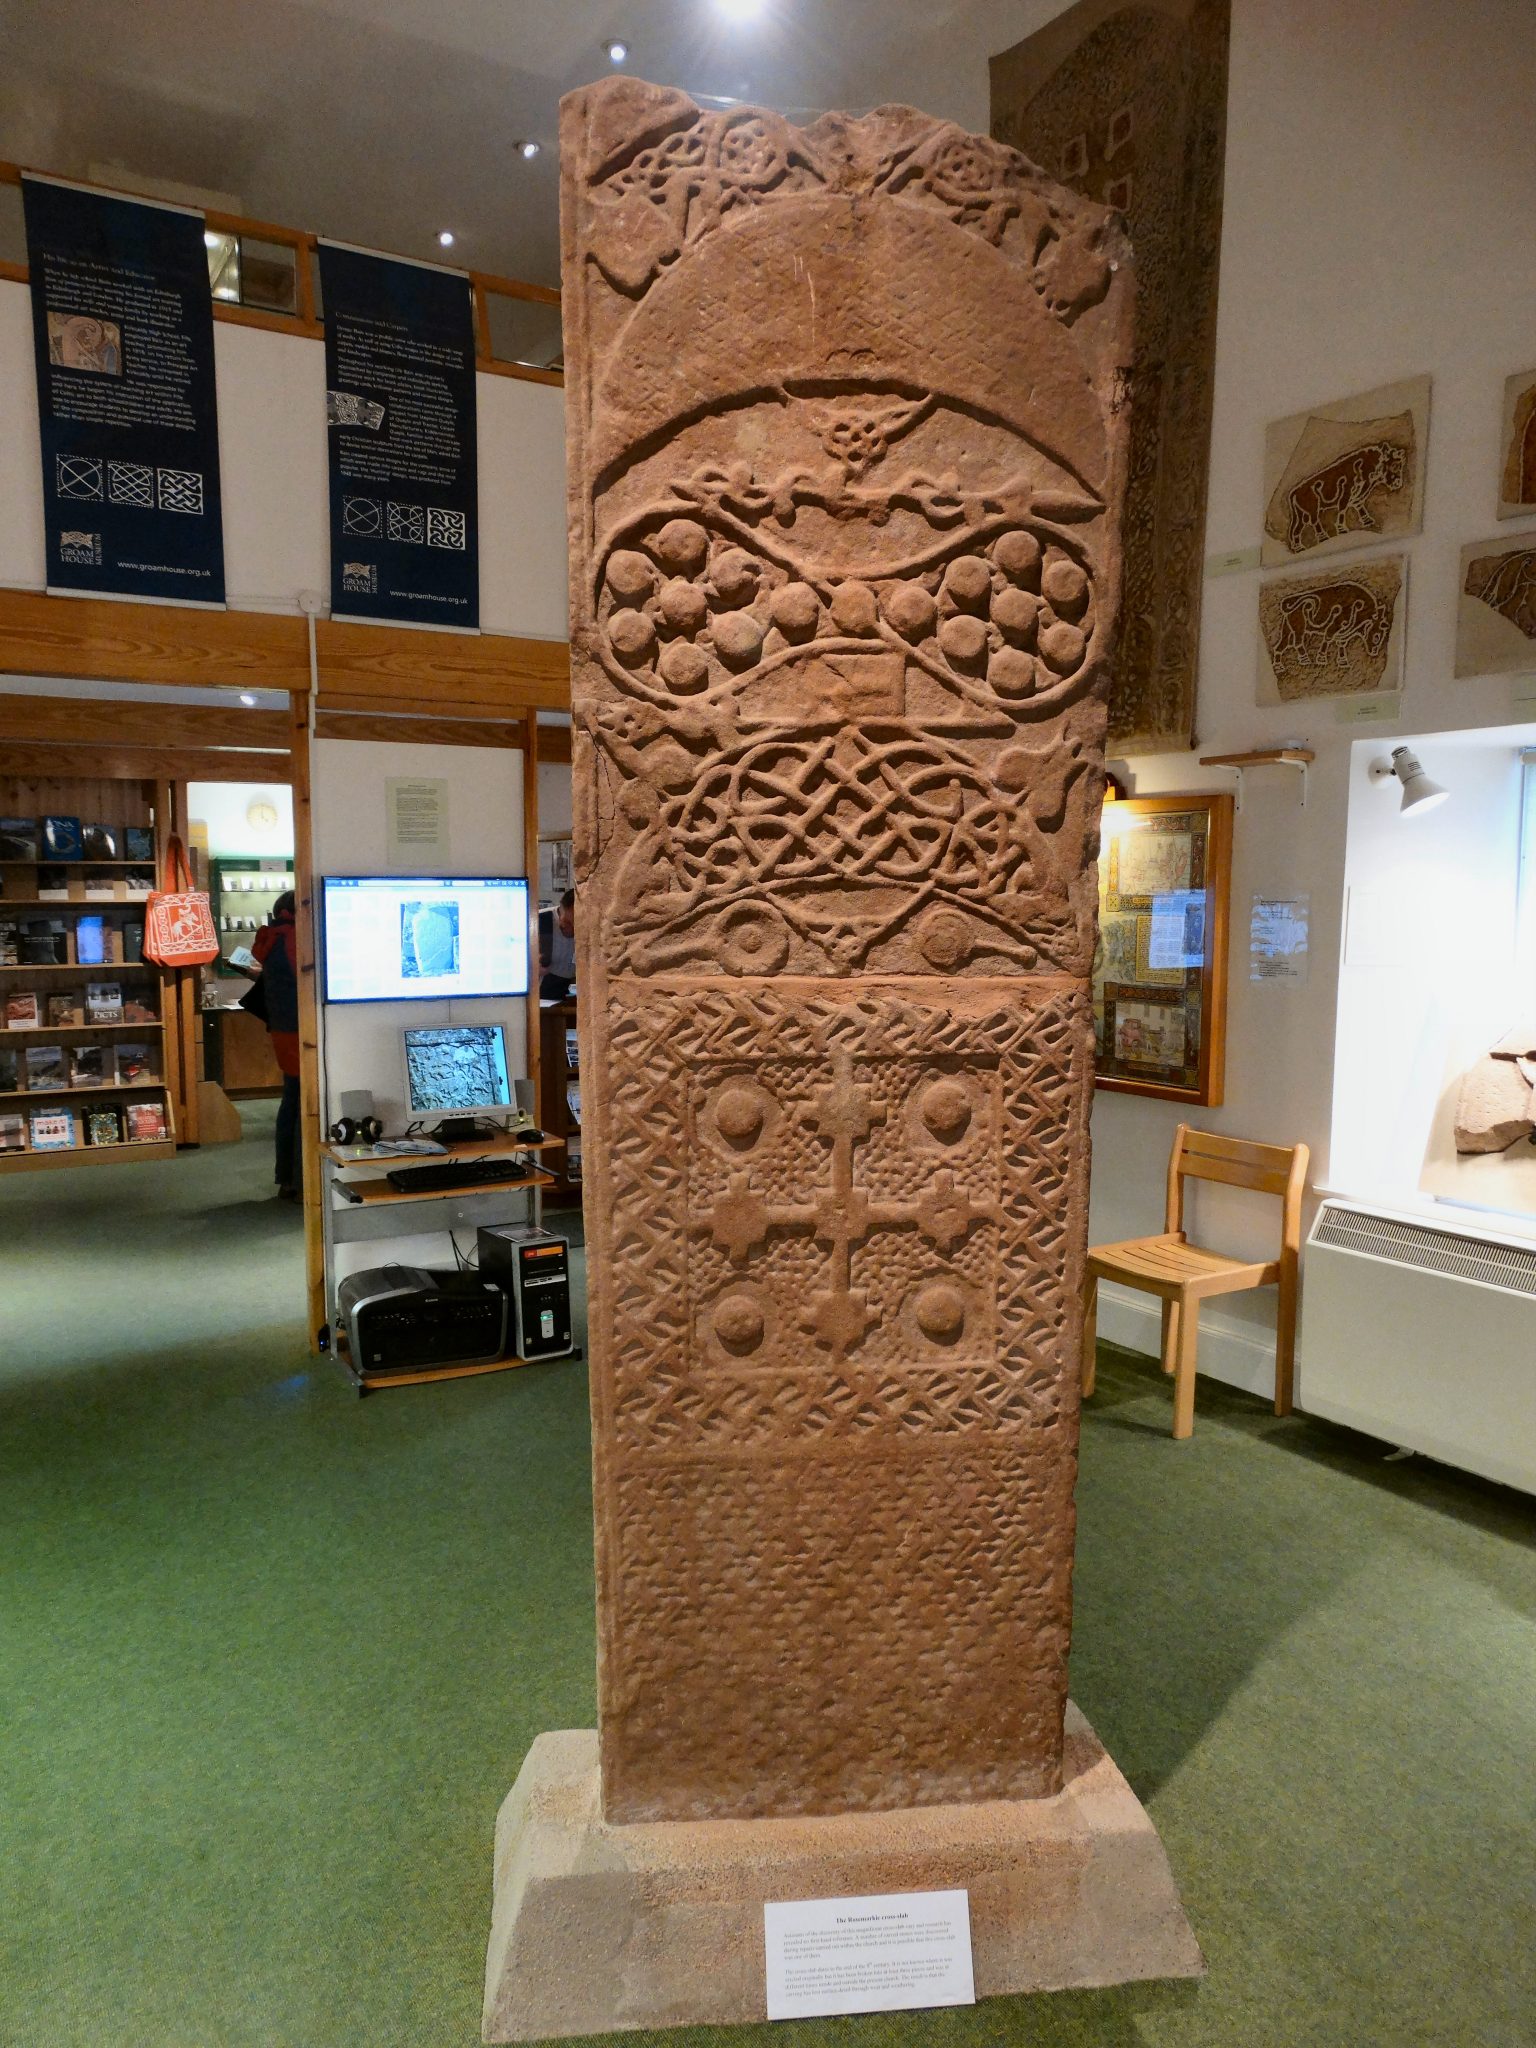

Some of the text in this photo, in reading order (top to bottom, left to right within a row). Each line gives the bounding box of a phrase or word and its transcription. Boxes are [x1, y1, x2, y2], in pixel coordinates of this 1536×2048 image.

[60, 548, 94, 558] GROAM
[61, 555, 94, 565] HOUSE
[117, 561, 211, 577] www.groamhouse.org.uk
[342, 577, 371, 587] GROAM
[343, 584, 371, 594] HOUSE
[389, 590, 468, 604] www.groamhouse.org.uk
[93, 1011, 118, 1019] PICTS
